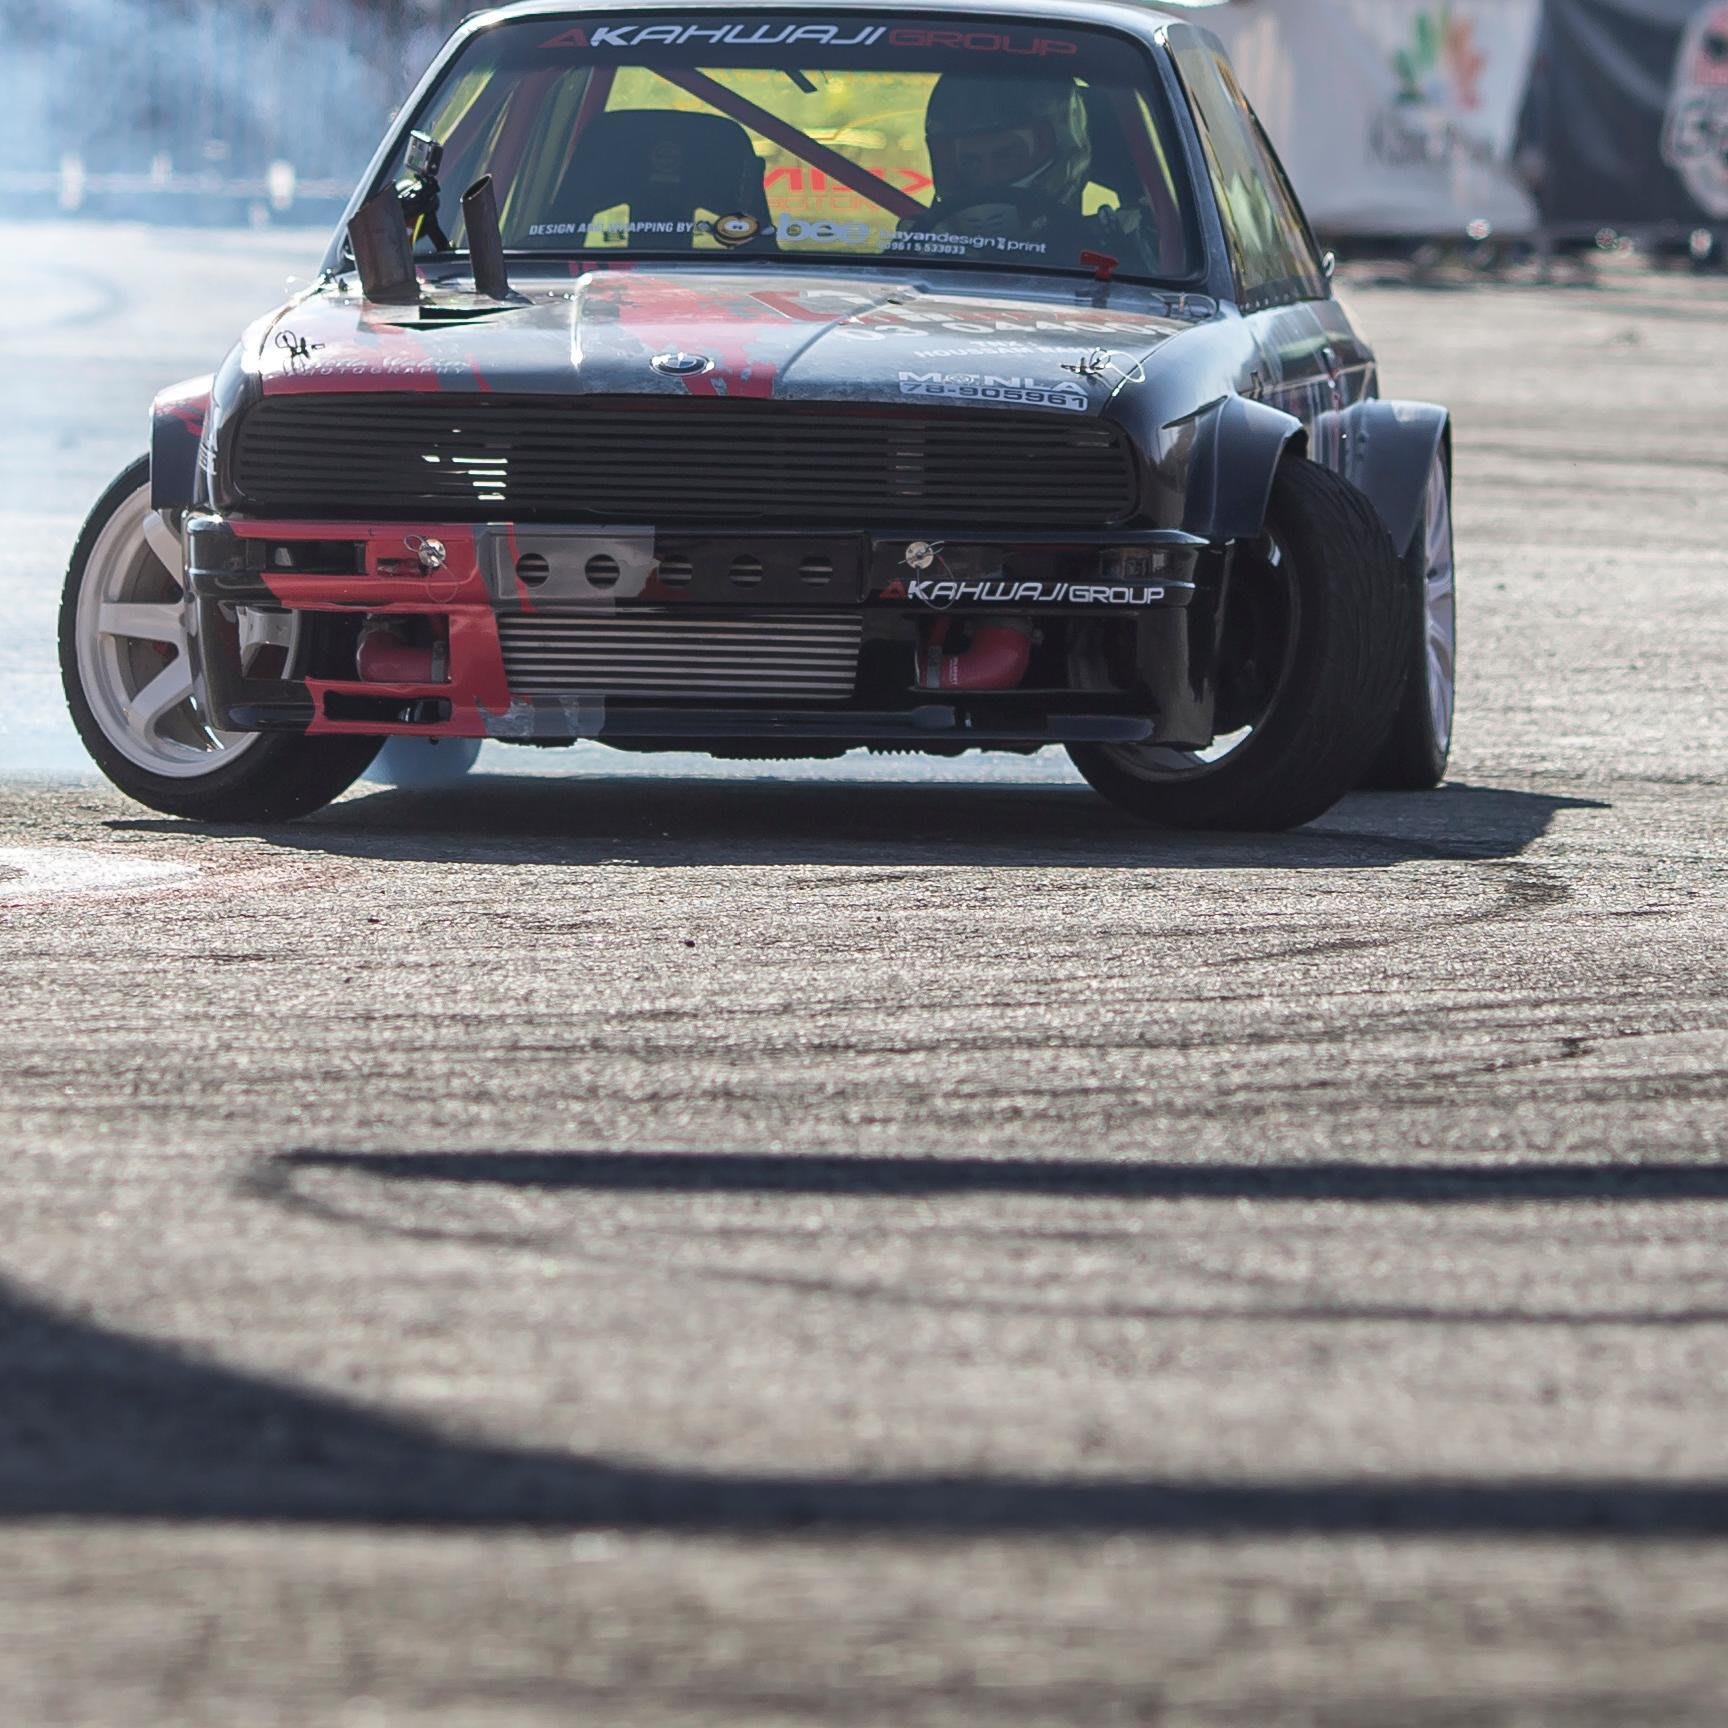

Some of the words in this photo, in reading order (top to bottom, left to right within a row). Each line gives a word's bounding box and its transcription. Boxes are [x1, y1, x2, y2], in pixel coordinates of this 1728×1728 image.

[676, 222, 694, 233] BY
[776, 213, 871, 244] bee
[1006, 240, 1047, 254] print
[901, 382, 1087, 411] 78-905961
